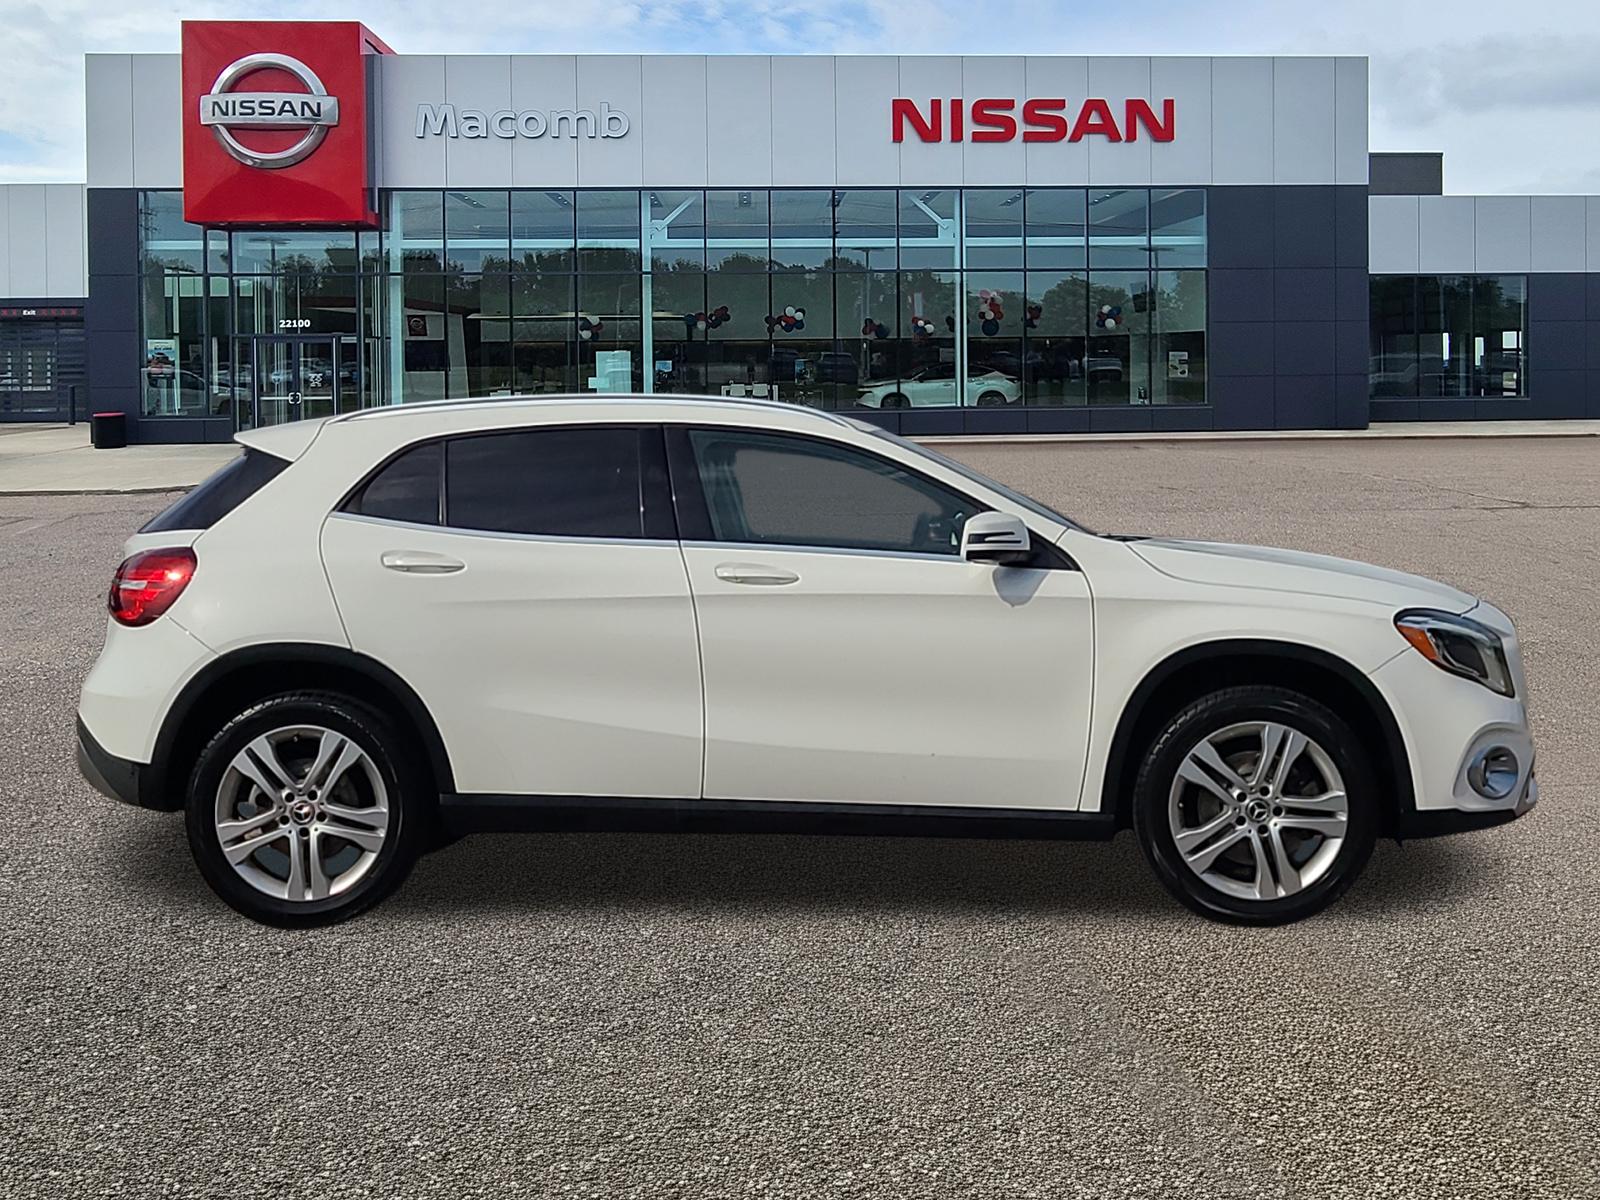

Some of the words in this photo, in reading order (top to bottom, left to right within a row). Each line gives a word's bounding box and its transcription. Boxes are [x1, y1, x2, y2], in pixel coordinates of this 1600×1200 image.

[211, 99, 322, 118] NISSAN
[415, 102, 631, 139] Macomb
[892, 98, 1176, 143] NISSAN
[279, 319, 311, 328] 22100
